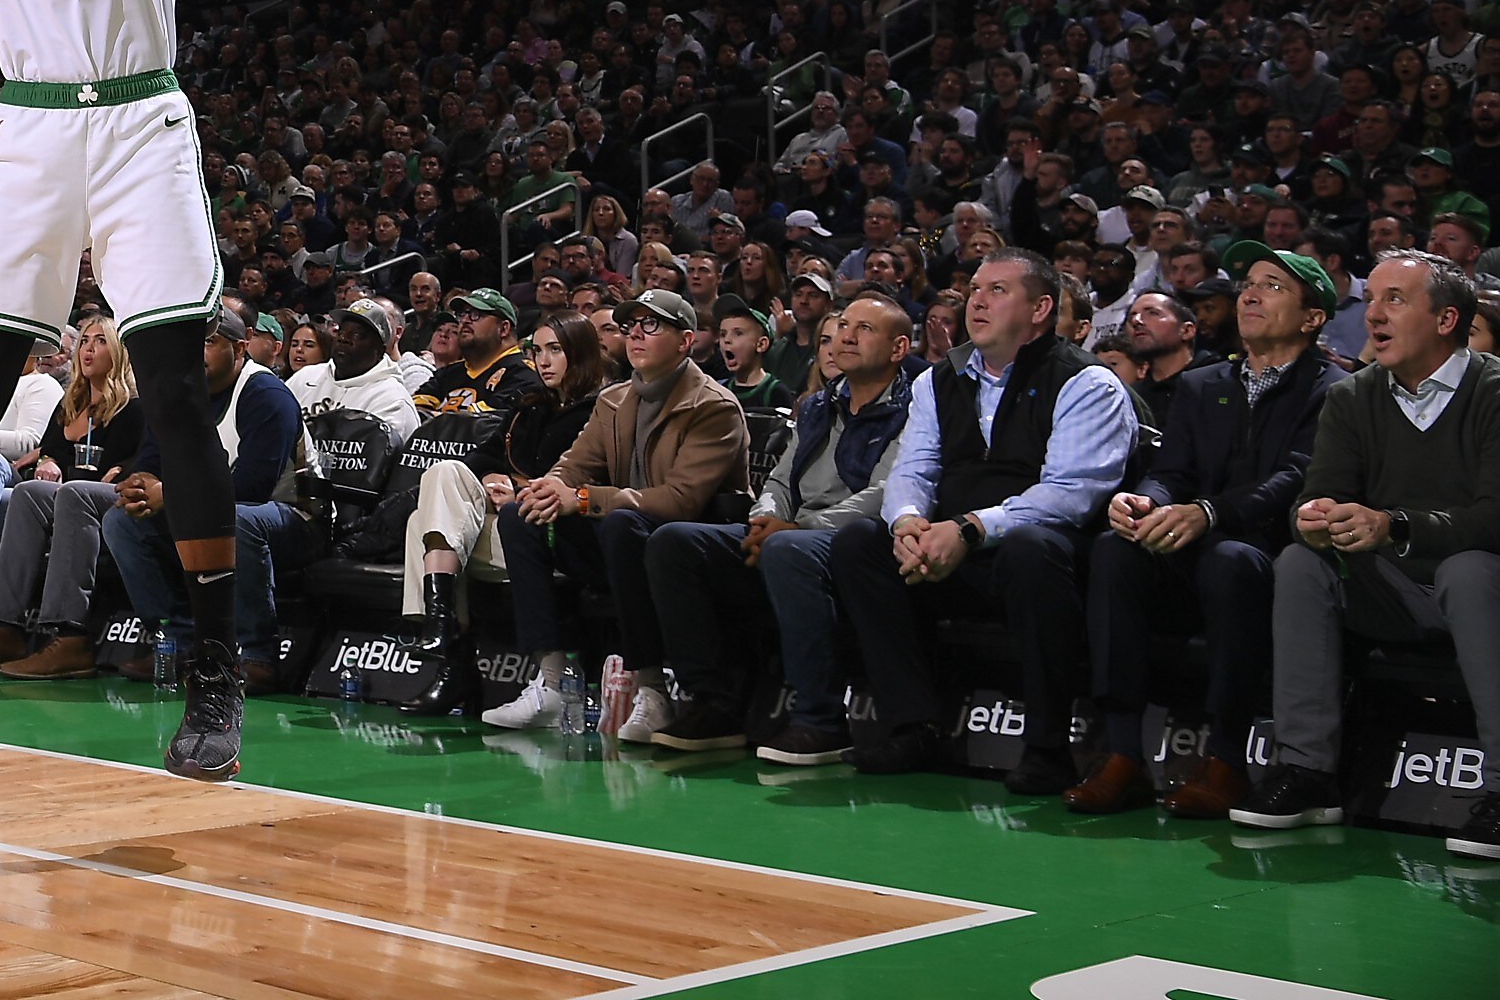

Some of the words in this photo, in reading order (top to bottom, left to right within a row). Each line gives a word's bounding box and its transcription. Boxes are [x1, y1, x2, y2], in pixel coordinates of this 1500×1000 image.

[485, 367, 507, 392] A
[313, 438, 366, 455] ANKLIN
[952, 696, 1026, 738] jetB
[1384, 740, 1485, 790] jetB
